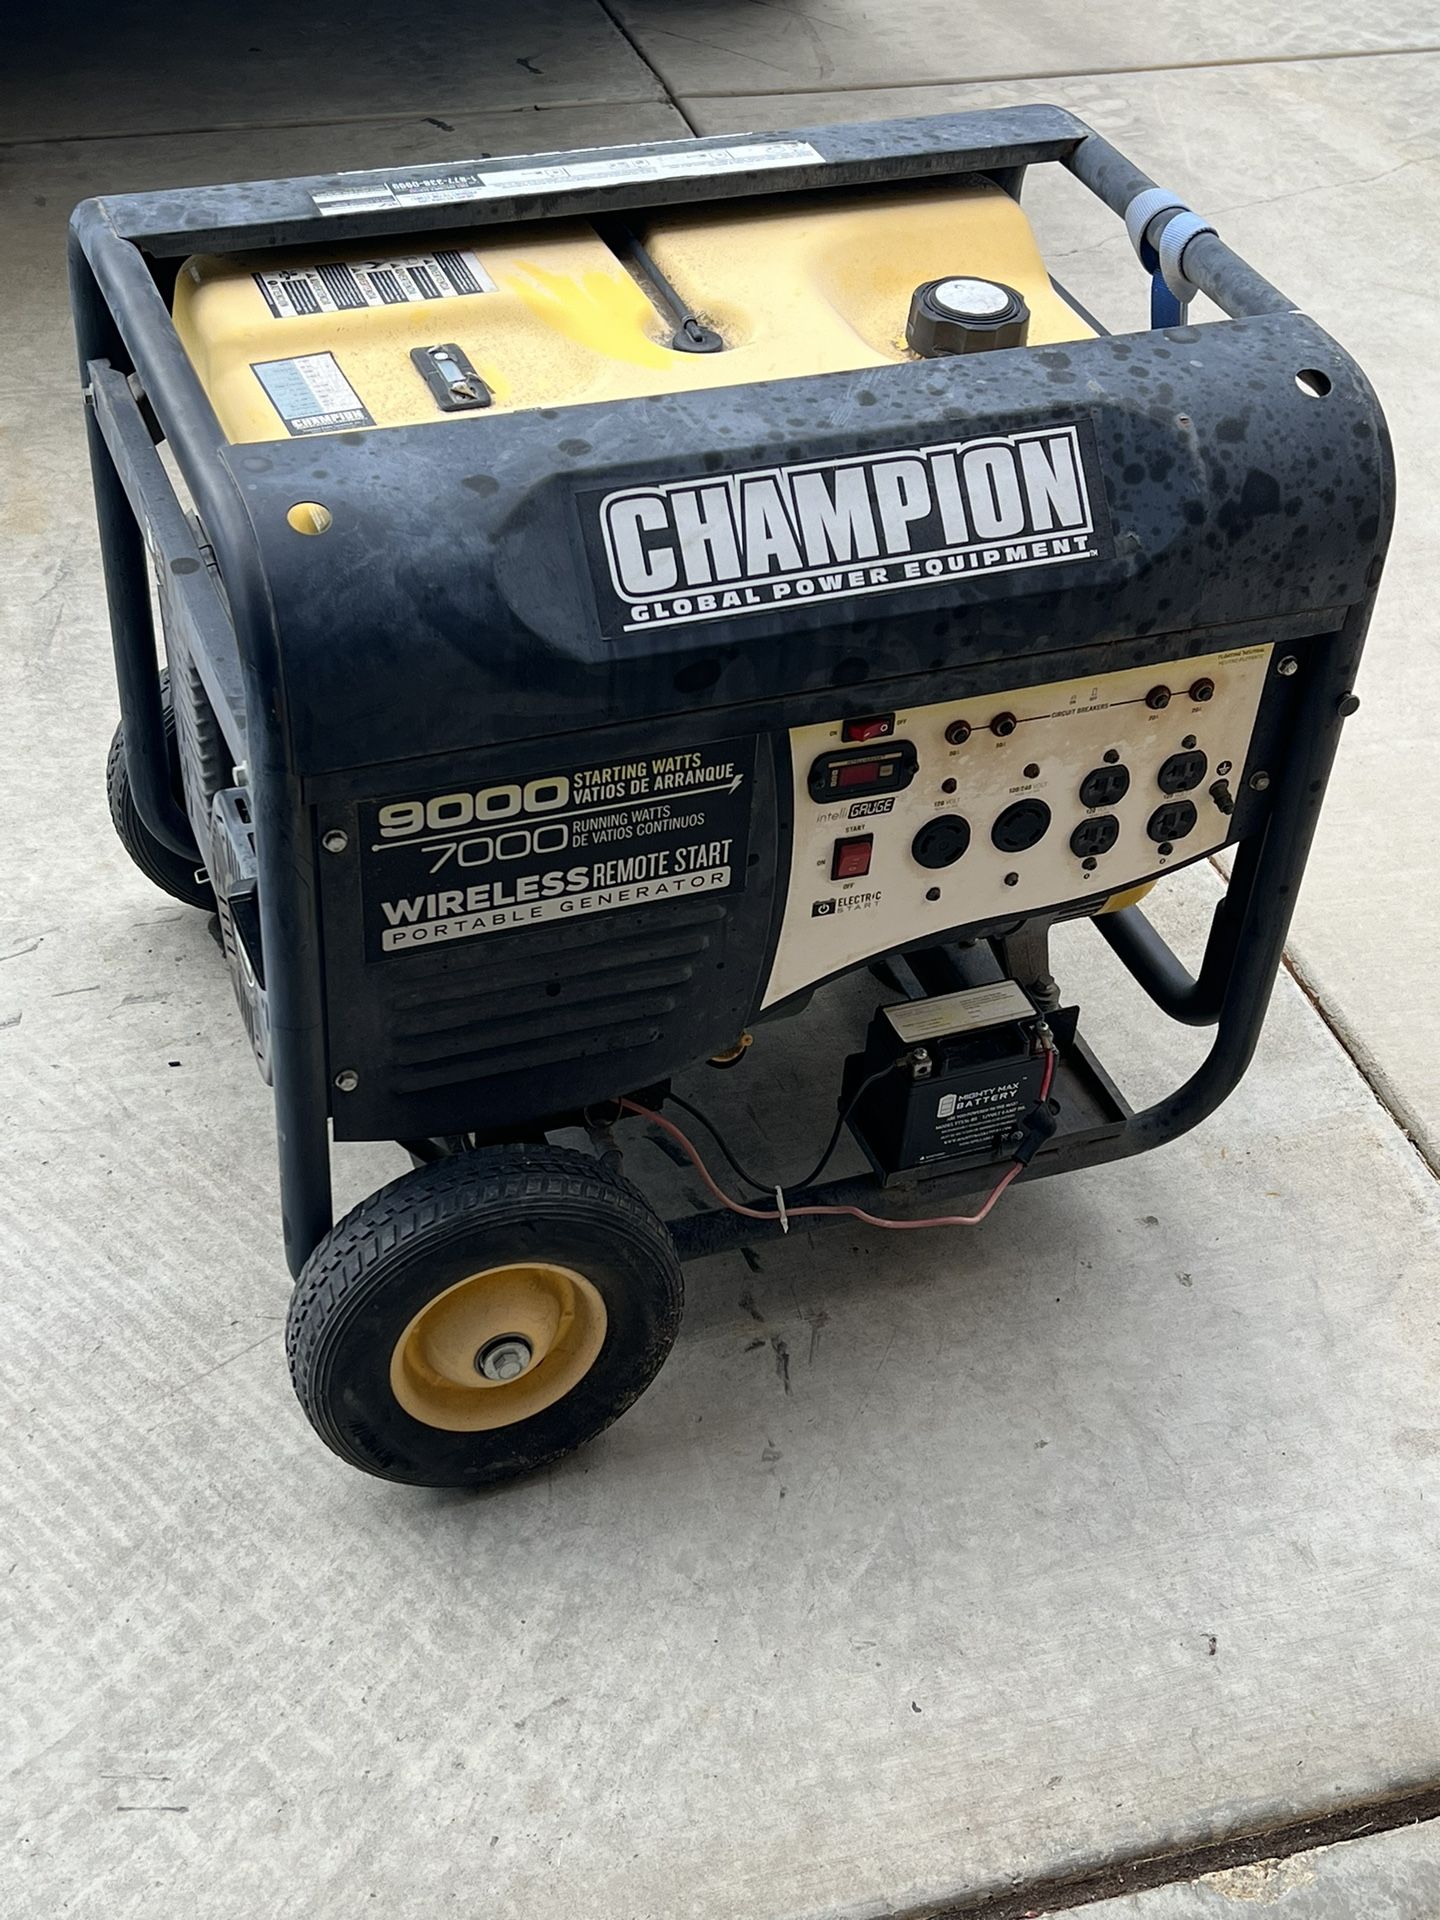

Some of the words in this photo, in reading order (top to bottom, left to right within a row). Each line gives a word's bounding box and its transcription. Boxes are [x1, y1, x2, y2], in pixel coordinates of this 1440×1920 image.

[608, 437, 1085, 595] CHAMPION
[630, 589, 761, 622] GLOBAL
[774, 568, 889, 600] POWER
[904, 535, 1089, 578] EQUIPMENT
[1051, 708, 1076, 718] CIRCUIT
[1077, 703, 1109, 714] BREAKERS
[573, 762, 647, 788] STARTING
[652, 753, 702, 774] WATTS
[573, 780, 626, 805] VATIOS
[630, 777, 650, 794] DE
[653, 763, 735, 790] ARRANQUE
[378, 776, 570, 838] 9000
[572, 813, 629, 834] RUNNING
[631, 805, 671, 823] WATTS
[572, 834, 589, 848] DE
[592, 827, 633, 845] VATIOS
[636, 812, 705, 837] CONTINUOS
[845, 824, 866, 833] START
[421, 824, 569, 874] 7000
[381, 866, 589, 926] WIRELESS
[593, 851, 668, 887] REMOTE
[674, 840, 733, 873] START
[838, 891, 882, 907] ELECTRIC
[842, 882, 855, 890] OFF
[392, 905, 543, 945] PORTABLE
[560, 871, 724, 913] GENERATOR
[837, 902, 880, 913] START
[956, 1090, 1018, 1110] BATTERY
[958, 1086, 996, 1101] MIGHTY
[997, 1082, 1021, 1094] MAX
